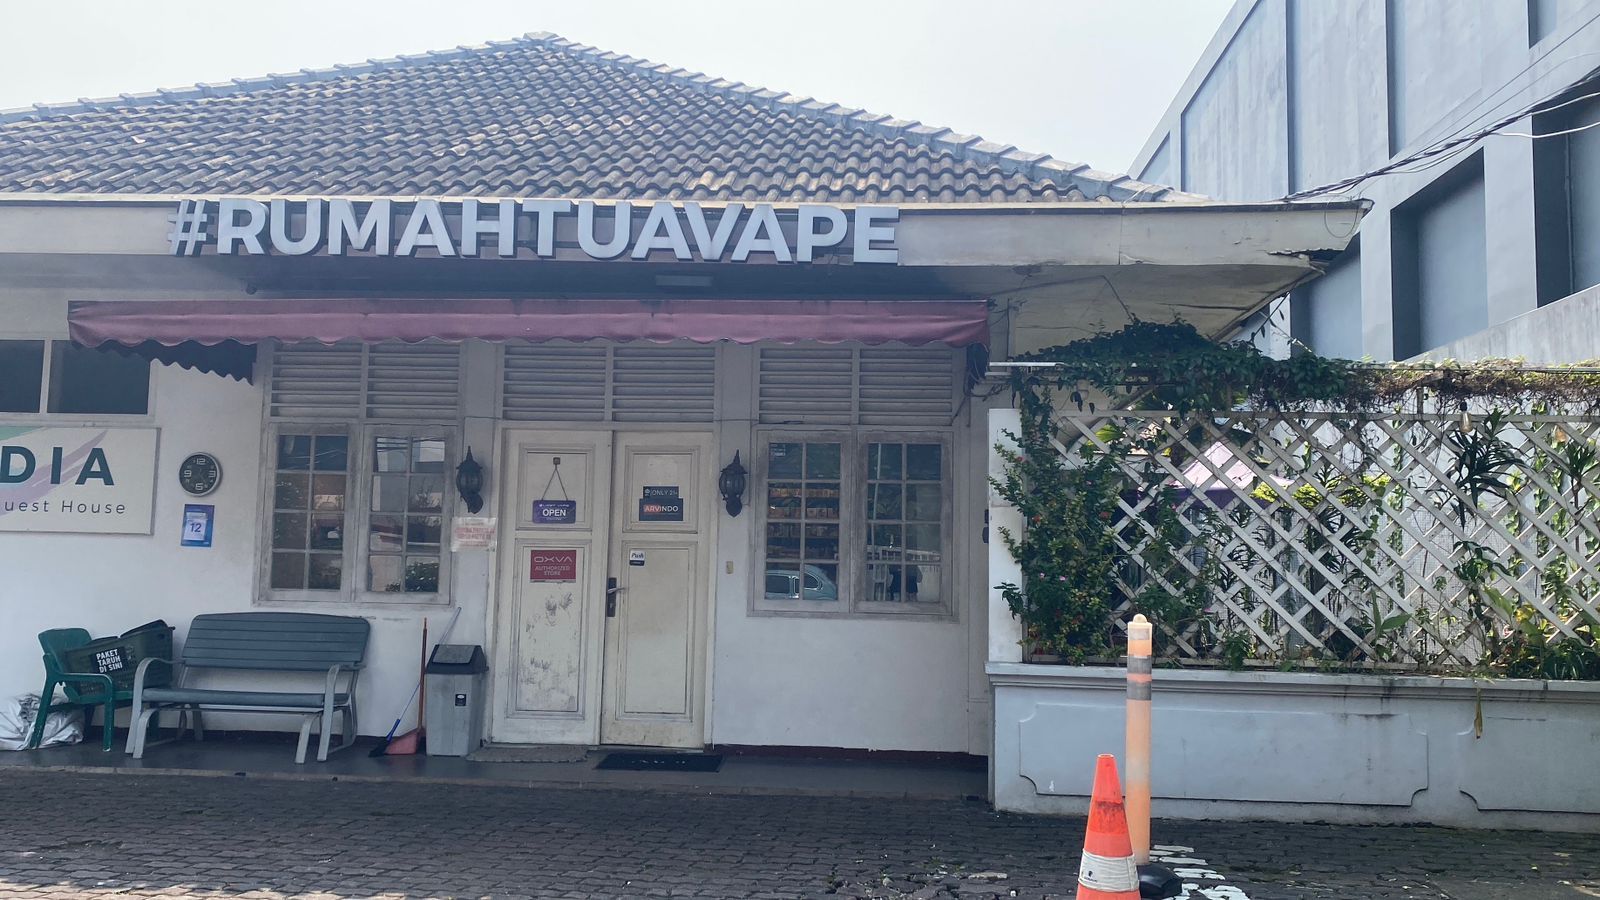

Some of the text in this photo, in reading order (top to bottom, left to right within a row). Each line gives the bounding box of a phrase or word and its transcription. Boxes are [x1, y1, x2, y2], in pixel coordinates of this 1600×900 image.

[167, 198, 899, 264] #RUMAHTUAVAPE
[0, 445, 115, 486] DIA
[196, 458, 206, 466] 12
[184, 469, 193, 478] 9
[208, 470, 216, 478] 3
[195, 482, 204, 491] 6
[61, 500, 126, 514] House
[542, 508, 567, 517] OPEN
[190, 523, 202, 533] 12
[96, 648, 118, 660] PAKET
[97, 655, 121, 666] TARUH
[99, 661, 123, 673] DI SINI
